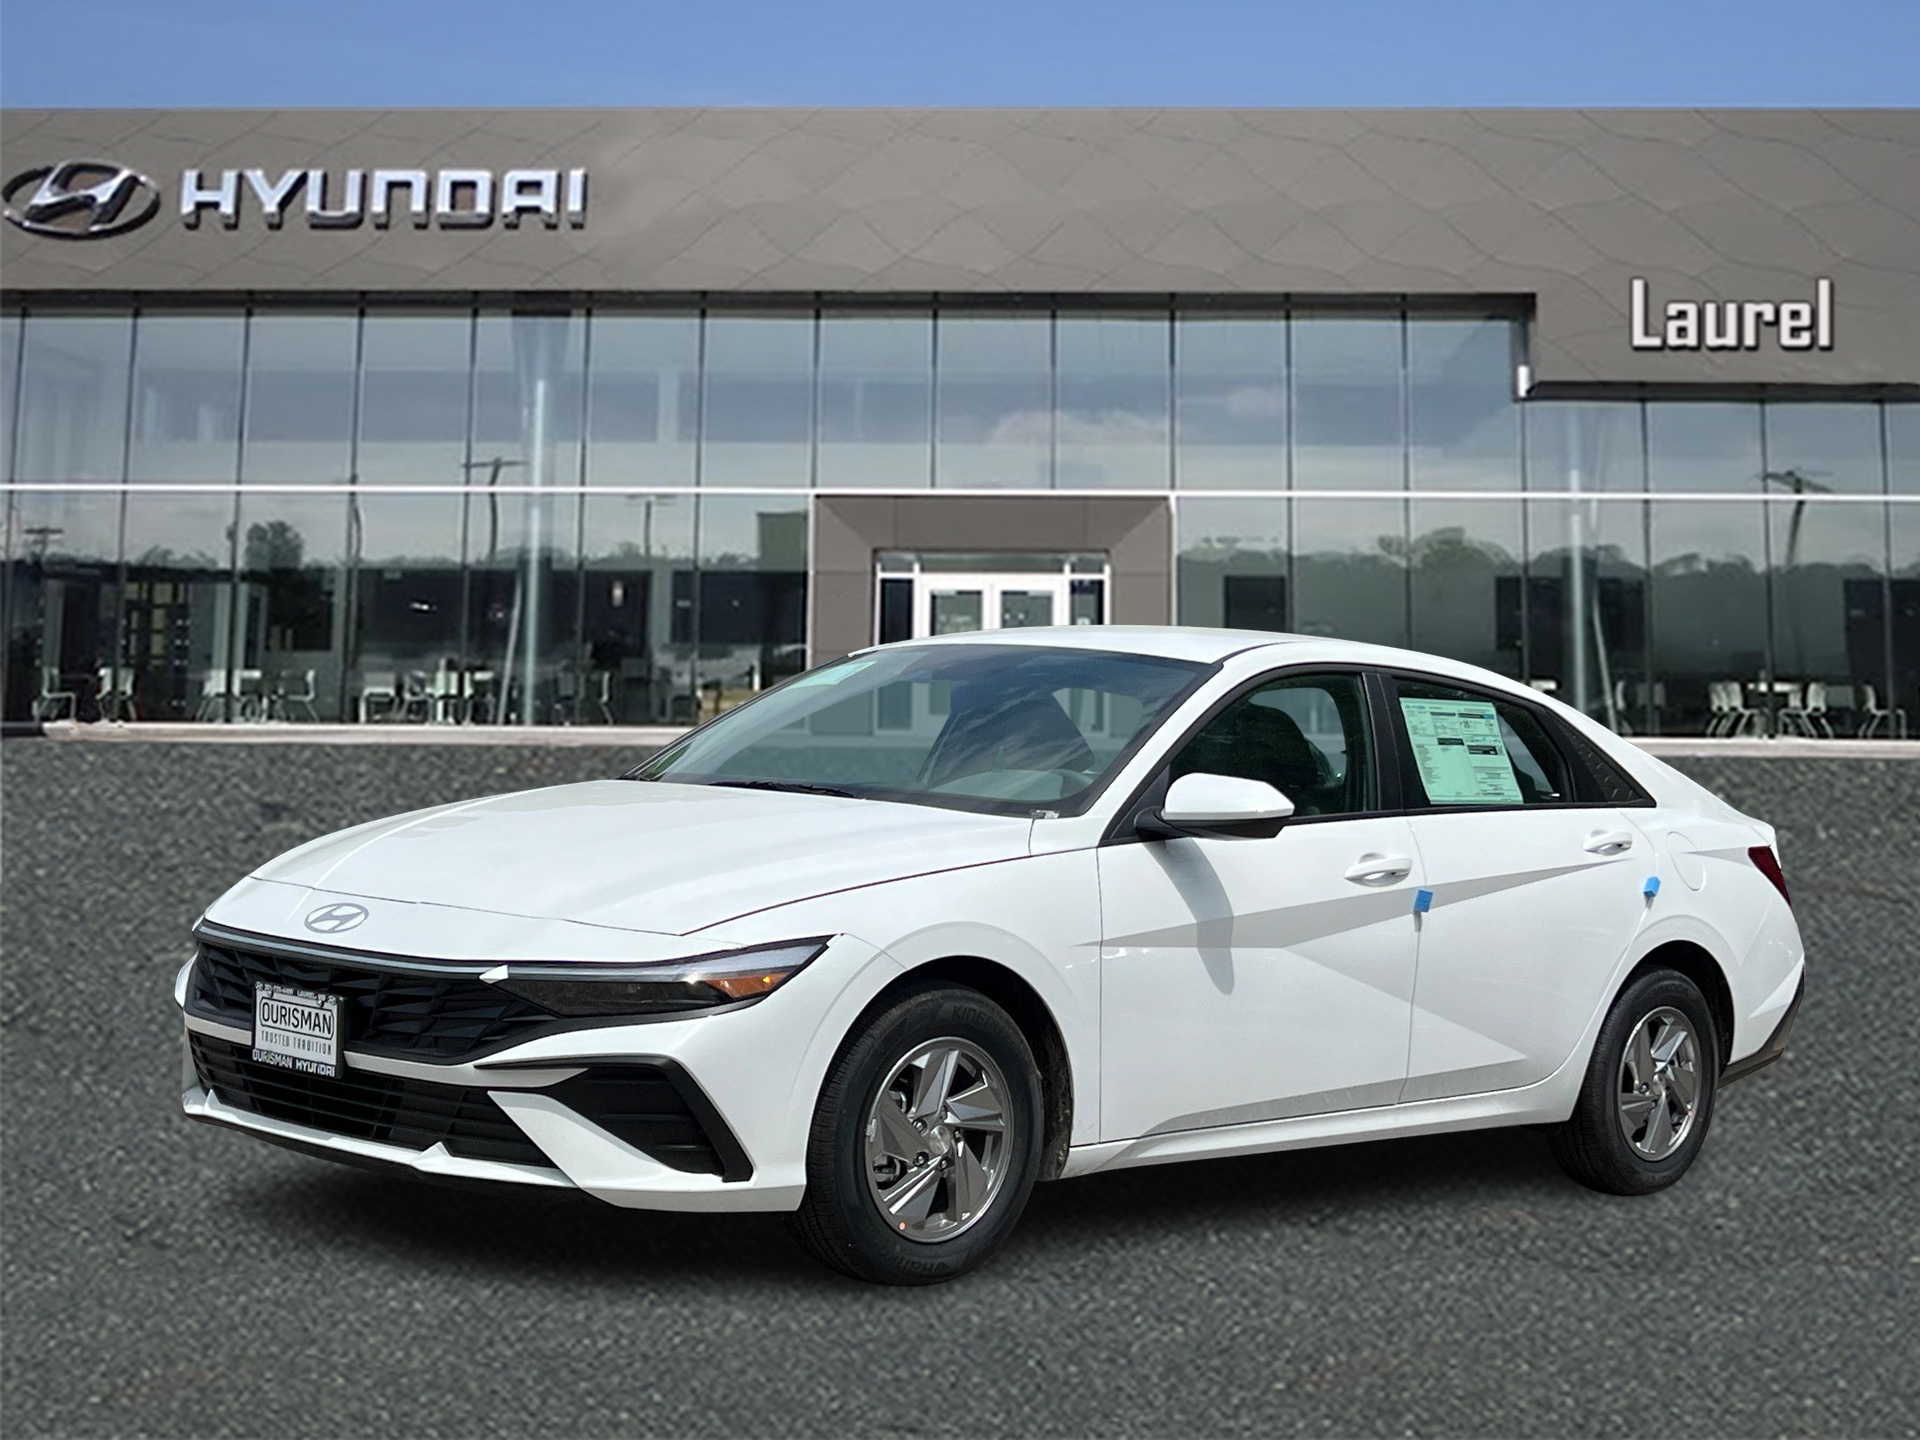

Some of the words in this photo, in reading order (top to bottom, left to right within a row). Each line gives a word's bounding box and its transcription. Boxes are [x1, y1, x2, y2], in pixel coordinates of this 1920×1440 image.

[179, 168, 588, 229] HYUNDAI
[1631, 278, 1832, 348] Laurel
[261, 1001, 332, 1035] OURISMAN
[261, 1030, 290, 1047] TRUSTED
[293, 1036, 331, 1056] TRADITION
[252, 1048, 293, 1069] OURISMAN
[295, 1058, 335, 1078] HYUNDAI
